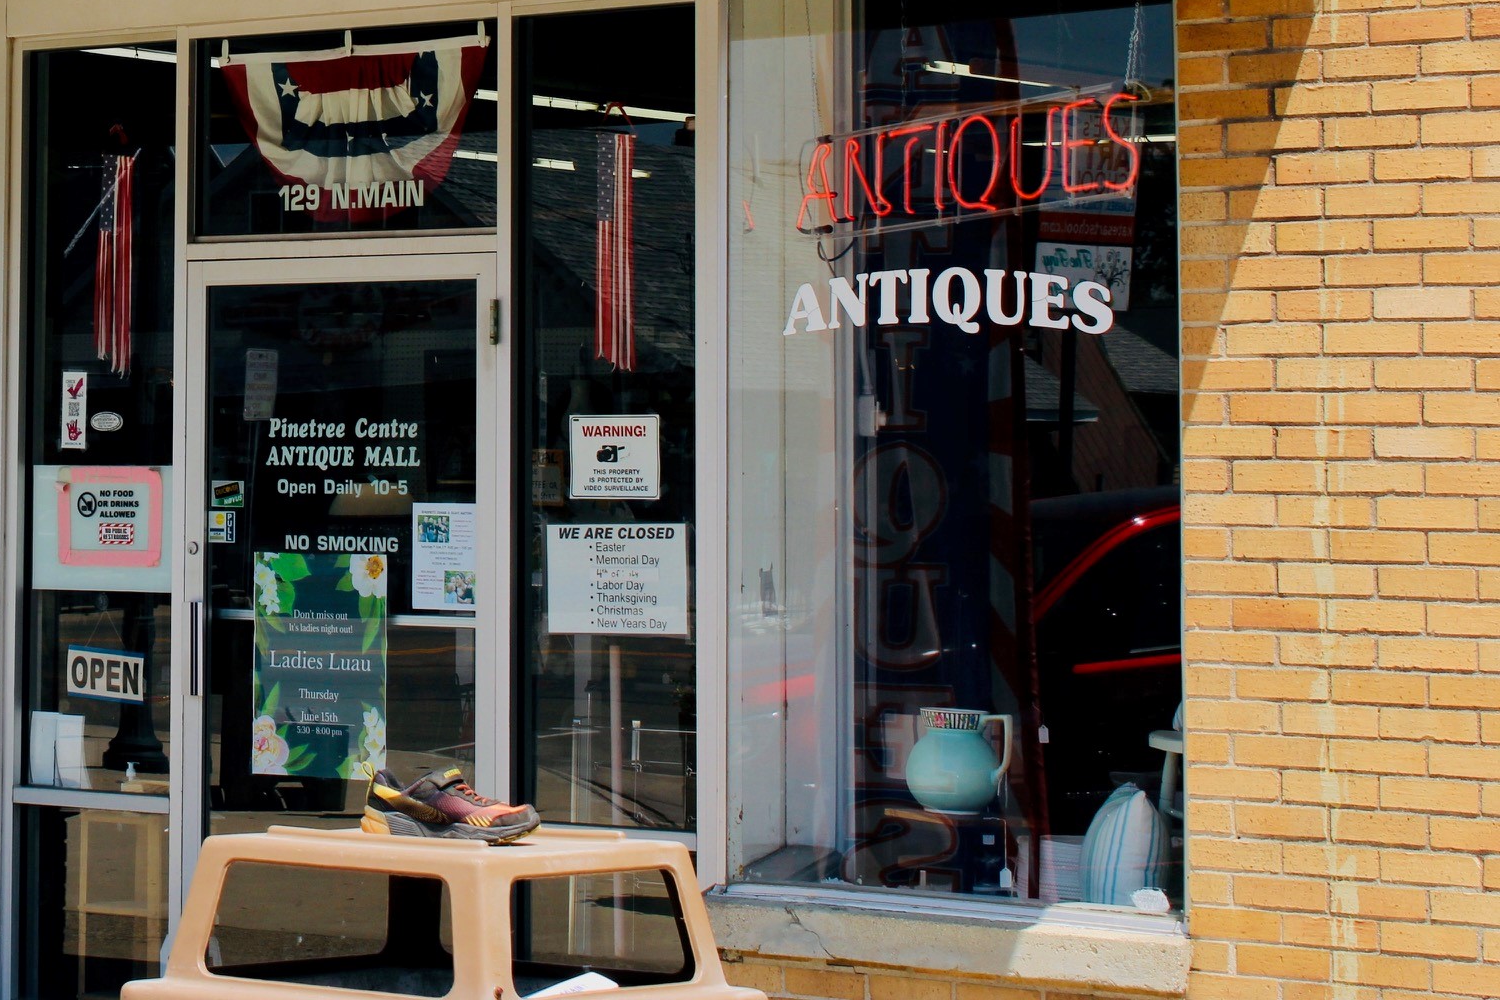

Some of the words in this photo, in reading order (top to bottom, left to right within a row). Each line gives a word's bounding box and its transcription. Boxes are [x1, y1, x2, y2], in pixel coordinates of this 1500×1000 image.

[796, 93, 1139, 234] ANTIQUES
[278, 183, 320, 212] 129
[782, 266, 1115, 336] ANTIQUES
[268, 417, 346, 438] Pinetree
[355, 417, 418, 438] Centre
[582, 425, 647, 437] WARNING!
[265, 446, 355, 471] ANTIQUE
[363, 446, 421, 467] MALL
[277, 478, 316, 498] Open
[324, 479, 362, 498] Daily
[369, 479, 408, 495] 10-5
[97, 500, 109, 508] OR
[110, 500, 140, 508] DRINKS
[558, 527, 580, 539] WE
[584, 527, 613, 539] ARE
[617, 527, 675, 539] CLOSED
[285, 534, 310, 550] NO
[317, 535, 399, 553] SMOKING
[595, 542, 626, 552] Easter
[596, 555, 639, 565] Memorial
[641, 555, 660, 567] Day
[596, 580, 623, 590] Labor
[626, 580, 645, 592] Day
[597, 593, 657, 605] Thanksgiving
[293, 609, 316, 620] Don't
[316, 609, 334, 620] miss
[335, 612, 348, 621] out
[596, 605, 644, 616] Christmas
[288, 623, 300, 632] It's
[300, 623, 320, 633] ladies
[320, 624, 339, 635] night
[339, 624, 353, 634] out!
[597, 618, 618, 628] New
[620, 618, 647, 629] Years
[649, 619, 668, 631] Day
[269, 650, 323, 670] Ladies
[329, 652, 372, 672] Luau
[71, 655, 140, 695] OPEN
[298, 688, 339, 703] Thursday
[300, 711, 319, 723] June
[320, 711, 339, 723] 15th
[315, 726, 331, 736] 8:00
[331, 729, 343, 737] pm
